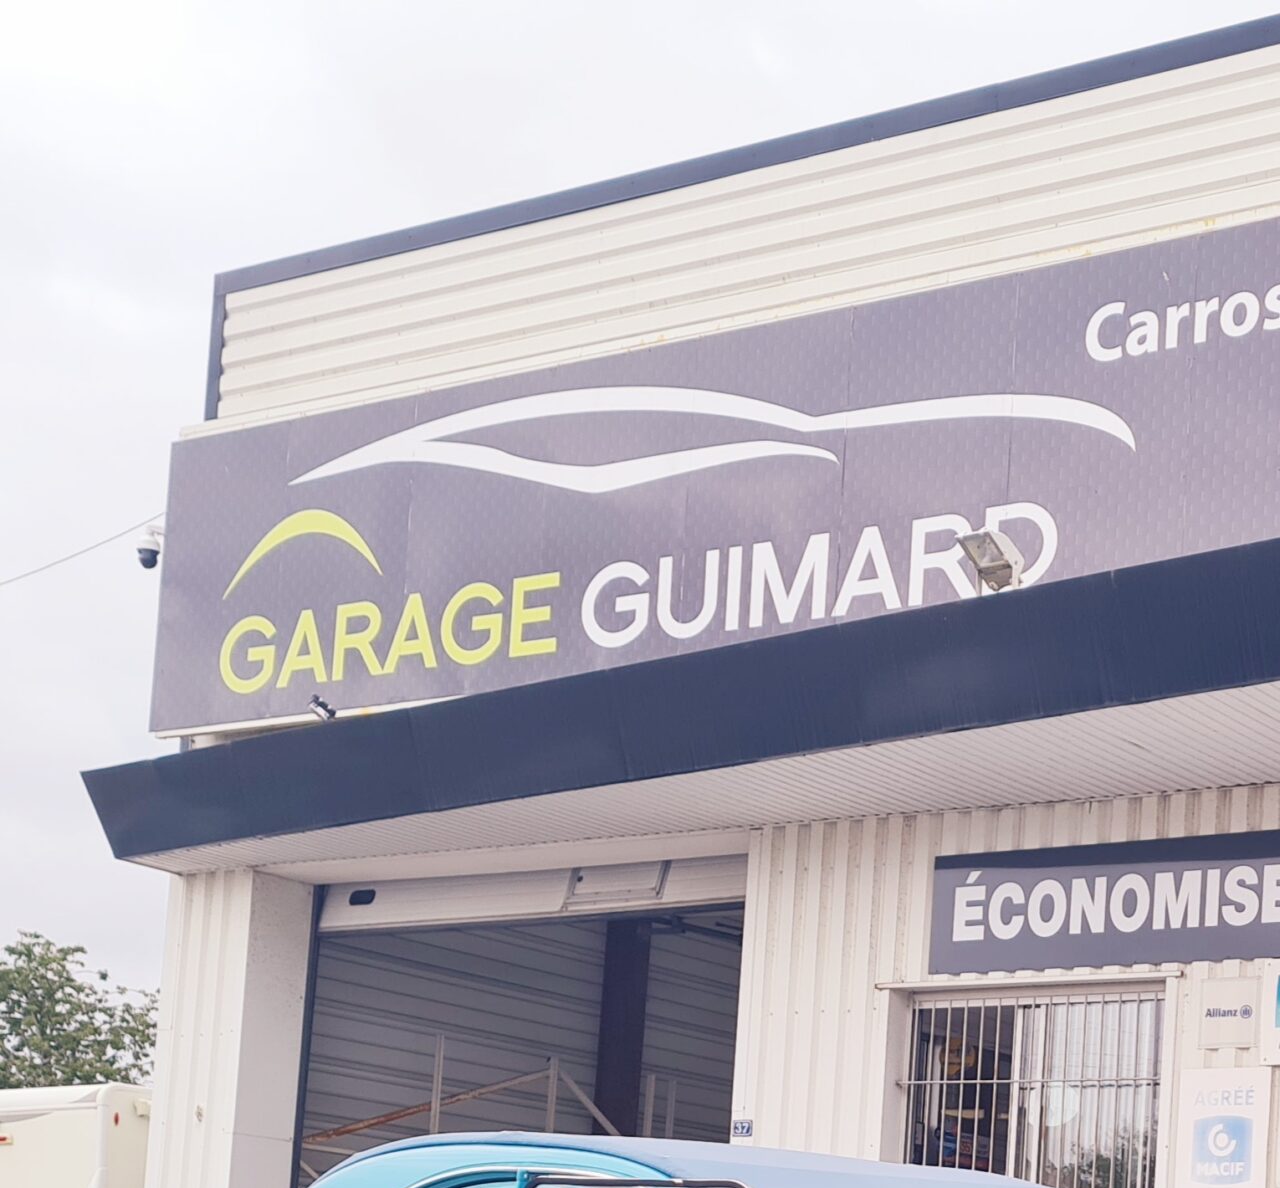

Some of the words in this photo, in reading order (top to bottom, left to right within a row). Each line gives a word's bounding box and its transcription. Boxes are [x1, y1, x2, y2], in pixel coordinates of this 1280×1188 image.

[218, 572, 561, 695] GARAGE
[580, 502, 1058, 650] GUIMARD
[1205, 1008, 1238, 1018] Allianz
[1194, 1086, 1255, 1106] AGRÉÉ
[735, 1122, 749, 1134] 37
[1196, 1162, 1246, 1177] MACIF
